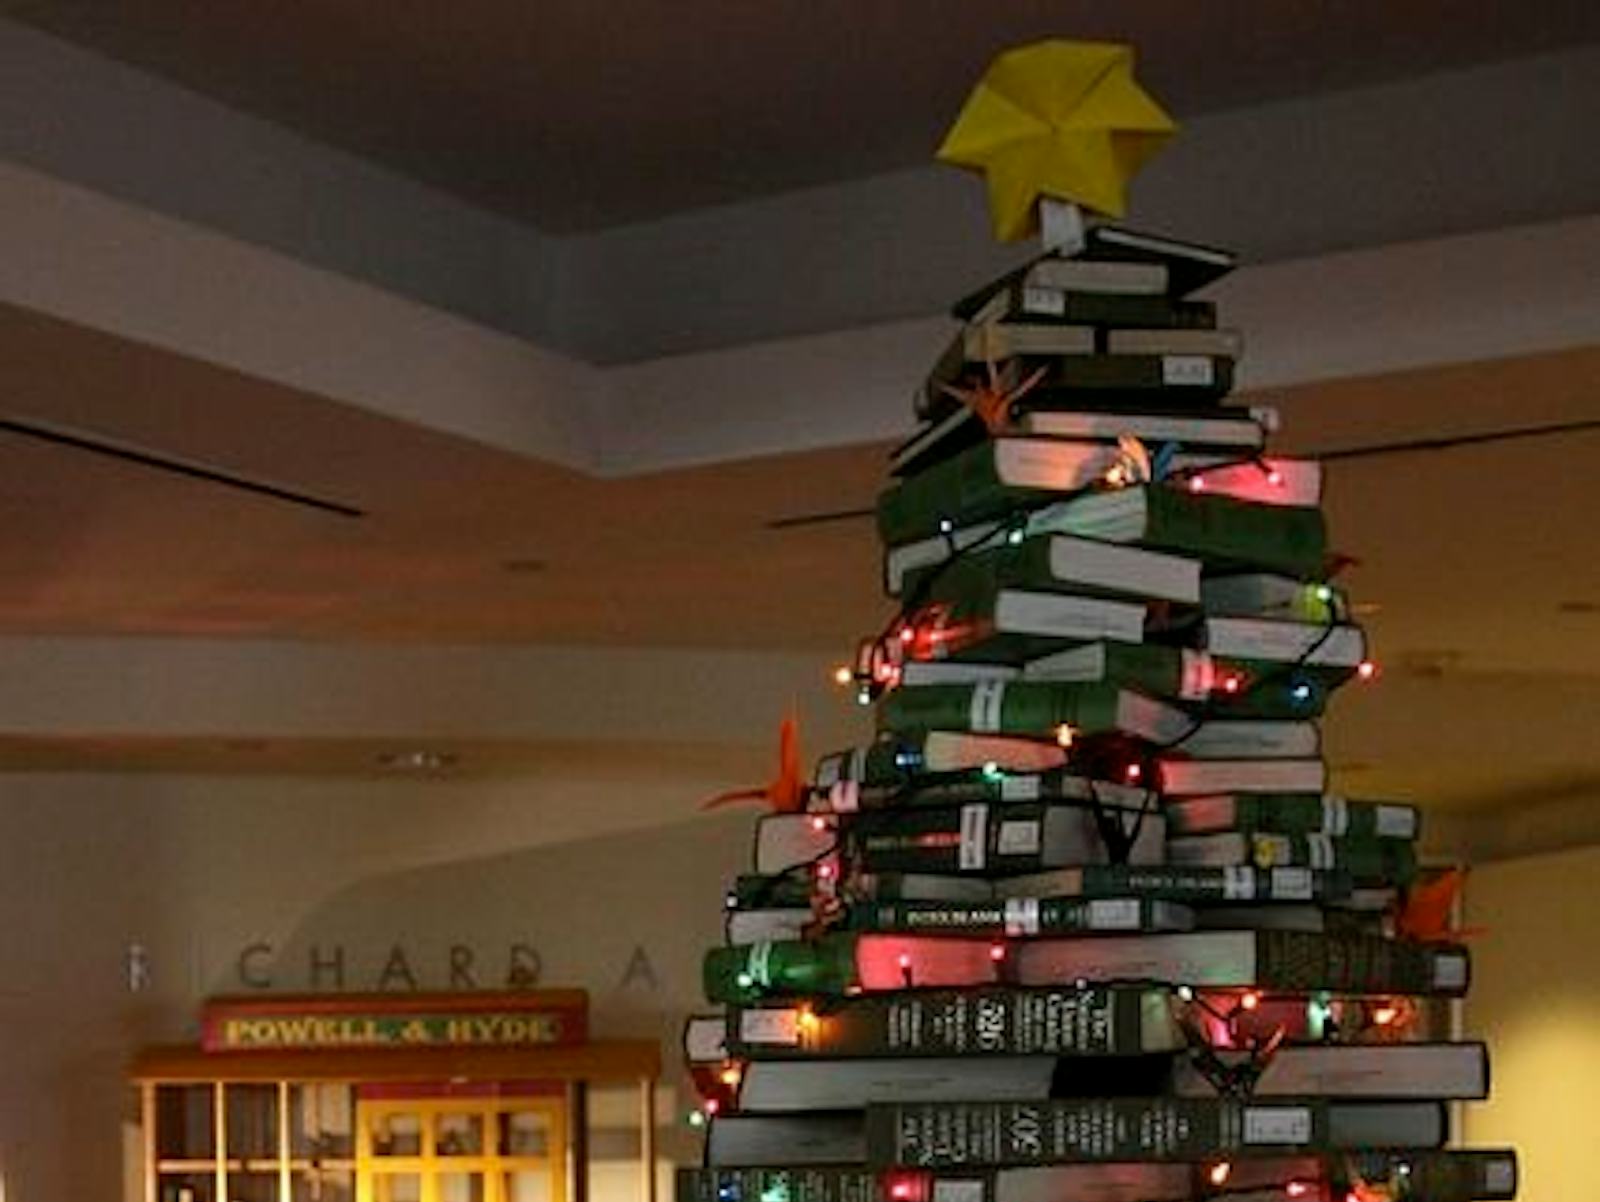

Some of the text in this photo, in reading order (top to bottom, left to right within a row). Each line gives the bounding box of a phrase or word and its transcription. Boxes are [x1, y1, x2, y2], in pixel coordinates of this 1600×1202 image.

[121, 944, 541, 990] RCHARD
[227, 1015, 562, 1046] POWELL & HYDE
